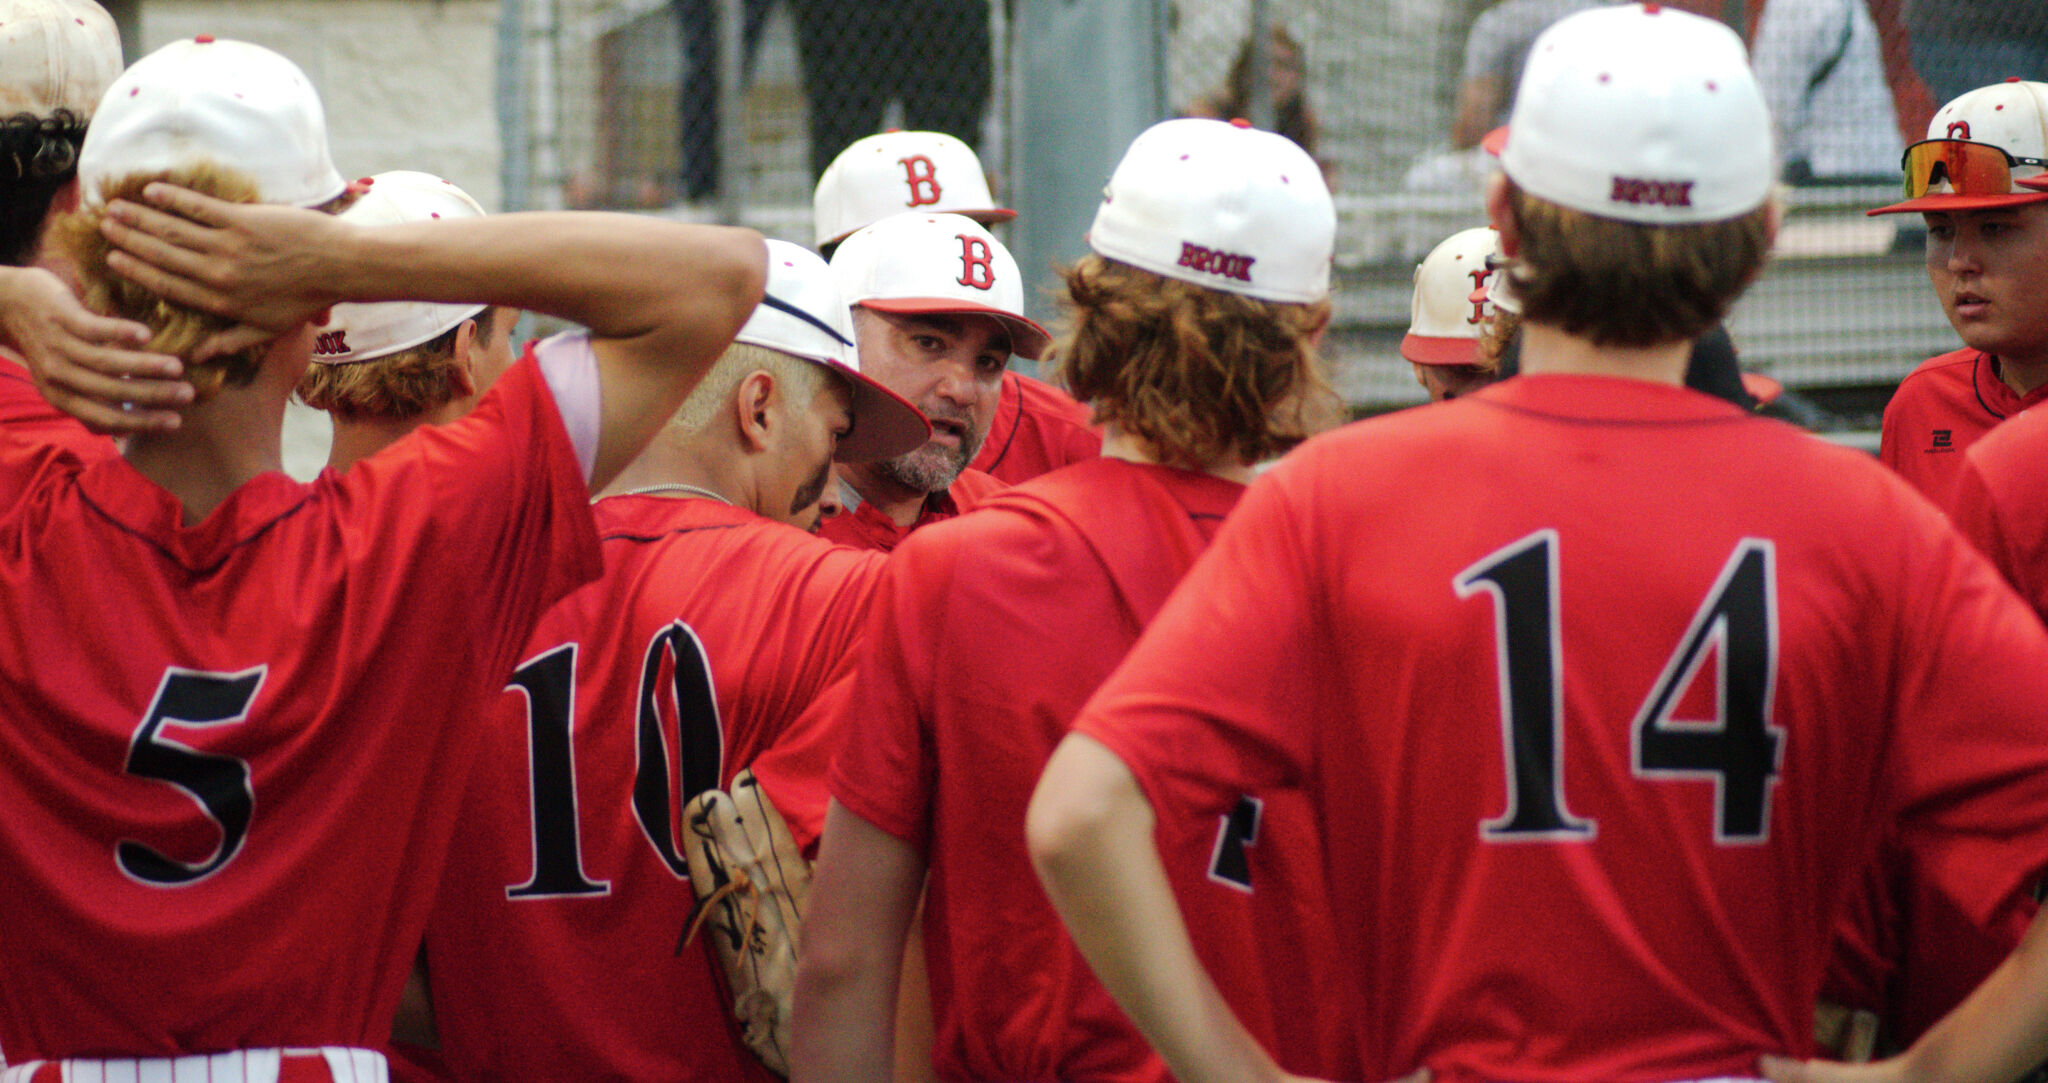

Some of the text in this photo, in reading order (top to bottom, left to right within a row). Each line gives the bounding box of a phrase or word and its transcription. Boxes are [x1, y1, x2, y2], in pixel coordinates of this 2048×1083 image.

[897, 154, 942, 208] B
[1610, 176, 1694, 207] BROOK
[955, 233, 996, 291] B
[1177, 241, 1257, 282] BROOK
[312, 330, 352, 355] OOK
[1452, 528, 1787, 846] 14
[114, 662, 268, 889] 5
[503, 617, 724, 901] 10
